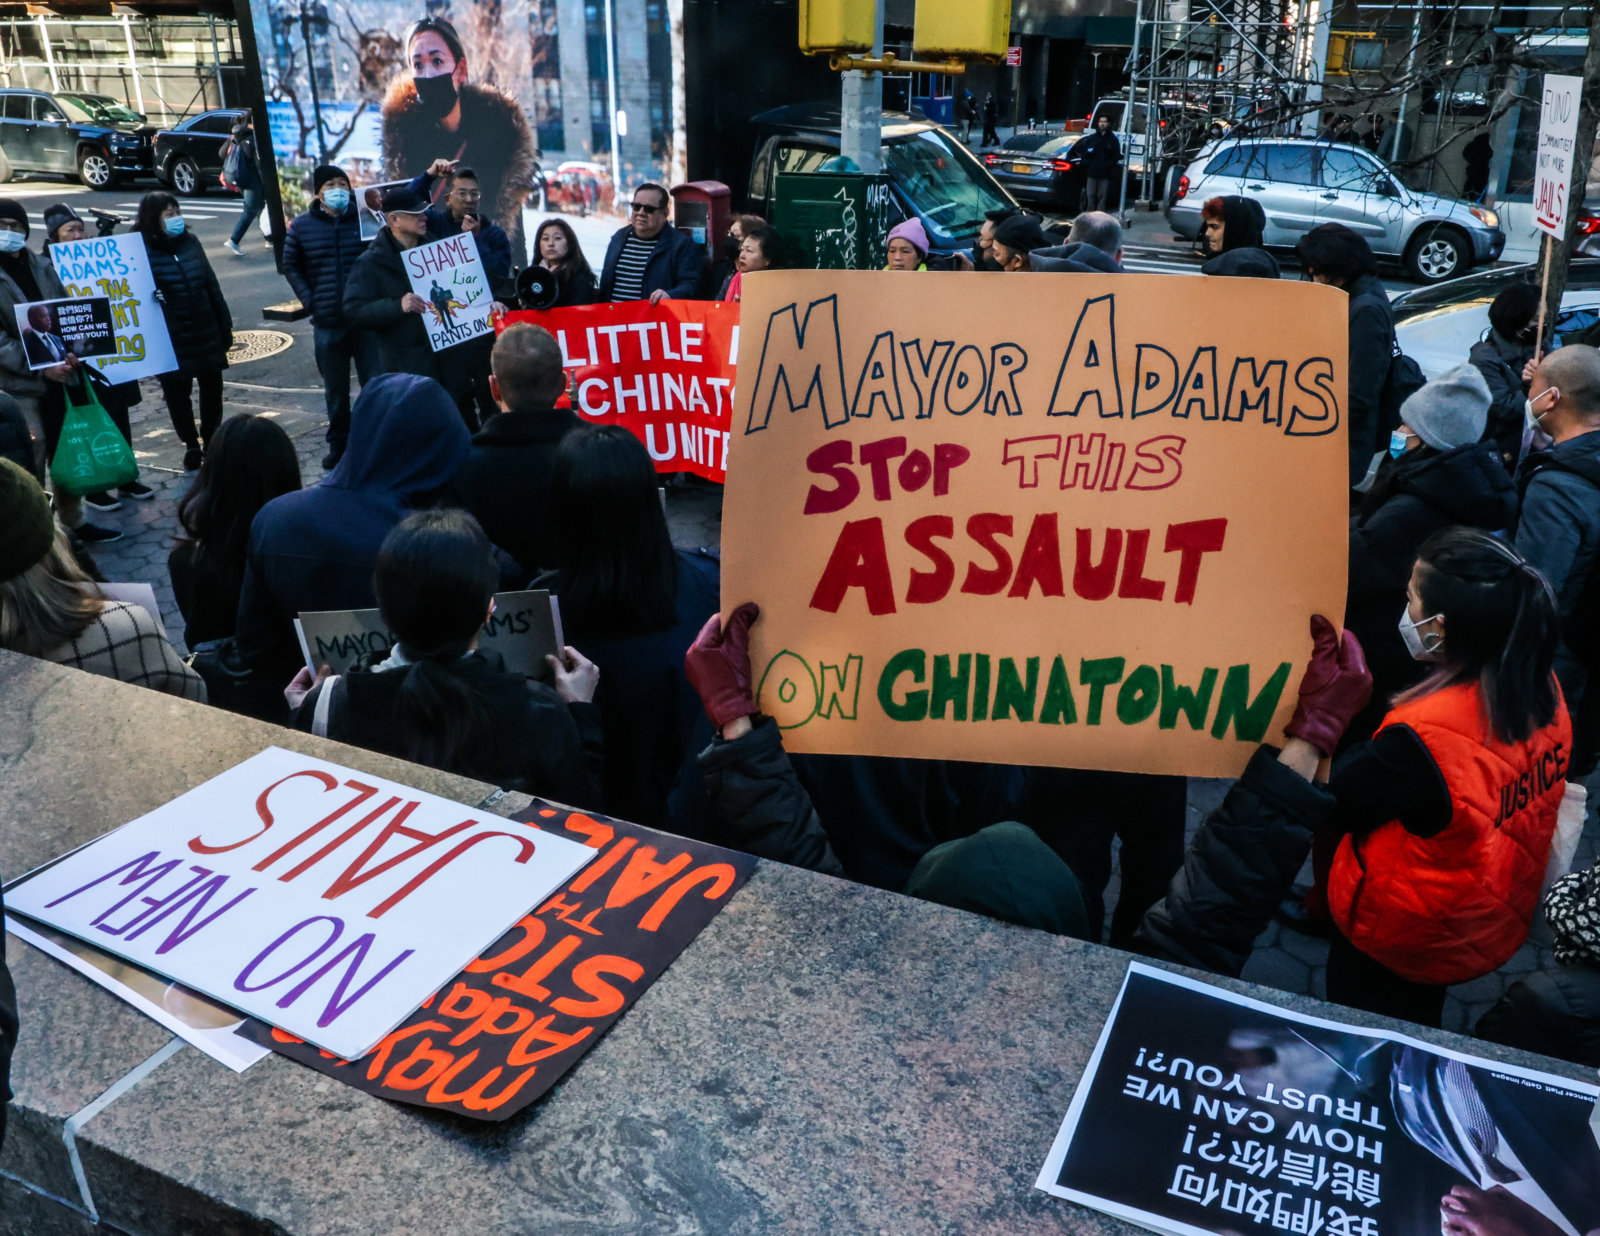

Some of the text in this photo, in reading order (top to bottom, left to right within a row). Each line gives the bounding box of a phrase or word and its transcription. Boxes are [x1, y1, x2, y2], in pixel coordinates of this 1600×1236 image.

[1544, 89, 1571, 124] FUND
[1540, 153, 1551, 168] NOT
[53, 238, 121, 263] MAYOR
[408, 235, 476, 279] SHAME
[452, 269, 478, 285] Liar
[465, 286, 484, 304] Liar
[61, 326, 78, 334] HOW
[62, 332, 84, 341] TRUST
[431, 317, 488, 350] PANTS ON
[556, 321, 703, 368] LITTLE
[744, 293, 1339, 436] MAYOR ADAMS
[578, 372, 736, 417] CHINAT
[645, 422, 731, 471] UNITE
[803, 433, 1186, 515] STOP THIS
[809, 512, 1228, 616] ASSAULT
[757, 649, 863, 730] ON
[1494, 743, 1565, 829] JUSTICE
[187, 770, 536, 919] JAILS
[535, 892, 603, 936] TH
[44, 851, 416, 1028] NO NEW
[463, 914, 644, 1018] STO
[421, 982, 594, 1066] Ada
[1134, 1047, 1387, 1131] TRUST YOU?!
[1491, 1072, 1520, 1084] Images
[1521, 1079, 1542, 1090] Getty
[1545, 1085, 1564, 1096] Platt
[1122, 1074, 1383, 1165] HOW CAN WE
[1182, 1124, 1381, 1207] 能信你?!
